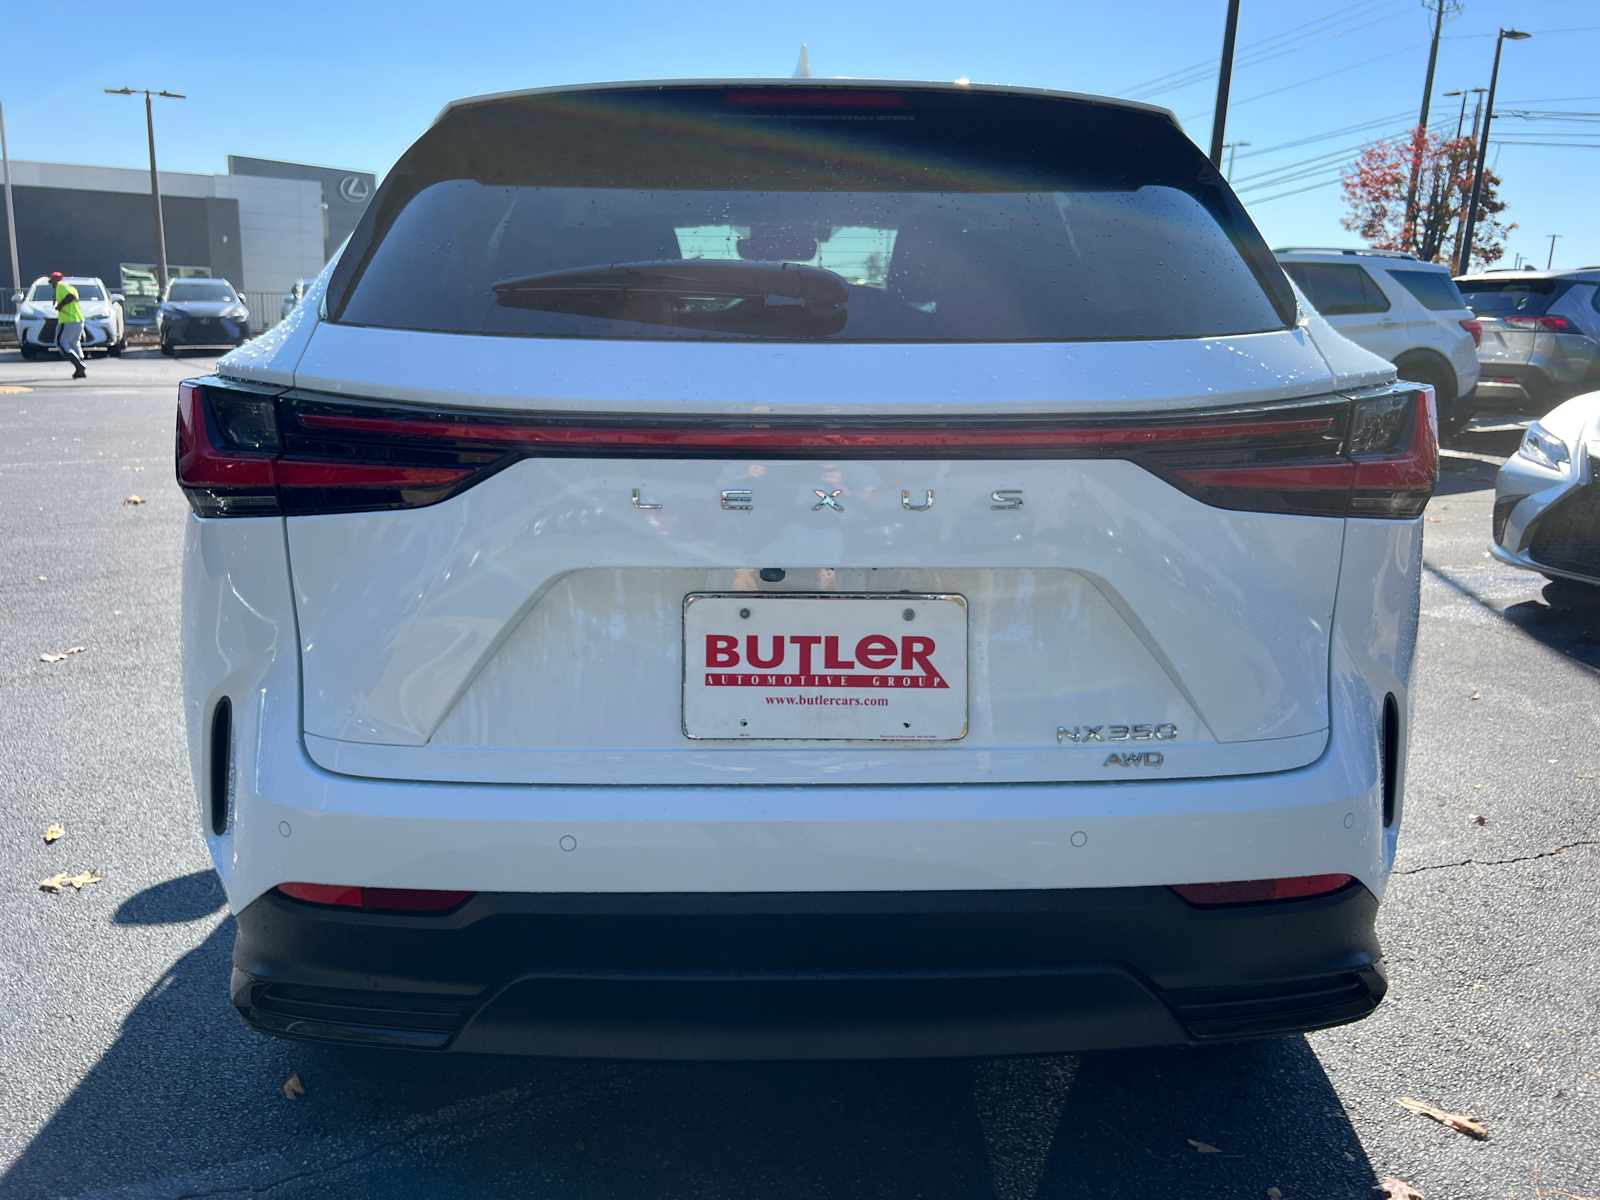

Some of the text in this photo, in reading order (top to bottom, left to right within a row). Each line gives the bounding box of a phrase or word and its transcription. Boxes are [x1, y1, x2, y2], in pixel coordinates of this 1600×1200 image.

[631, 488, 1024, 511] LEXUS
[706, 674, 941, 688] AUTOMOTIVE GROUP
[765, 694, 889, 707] www.butlercars.com
[1056, 723, 1178, 744] NX350
[1103, 752, 1164, 767] AWD
